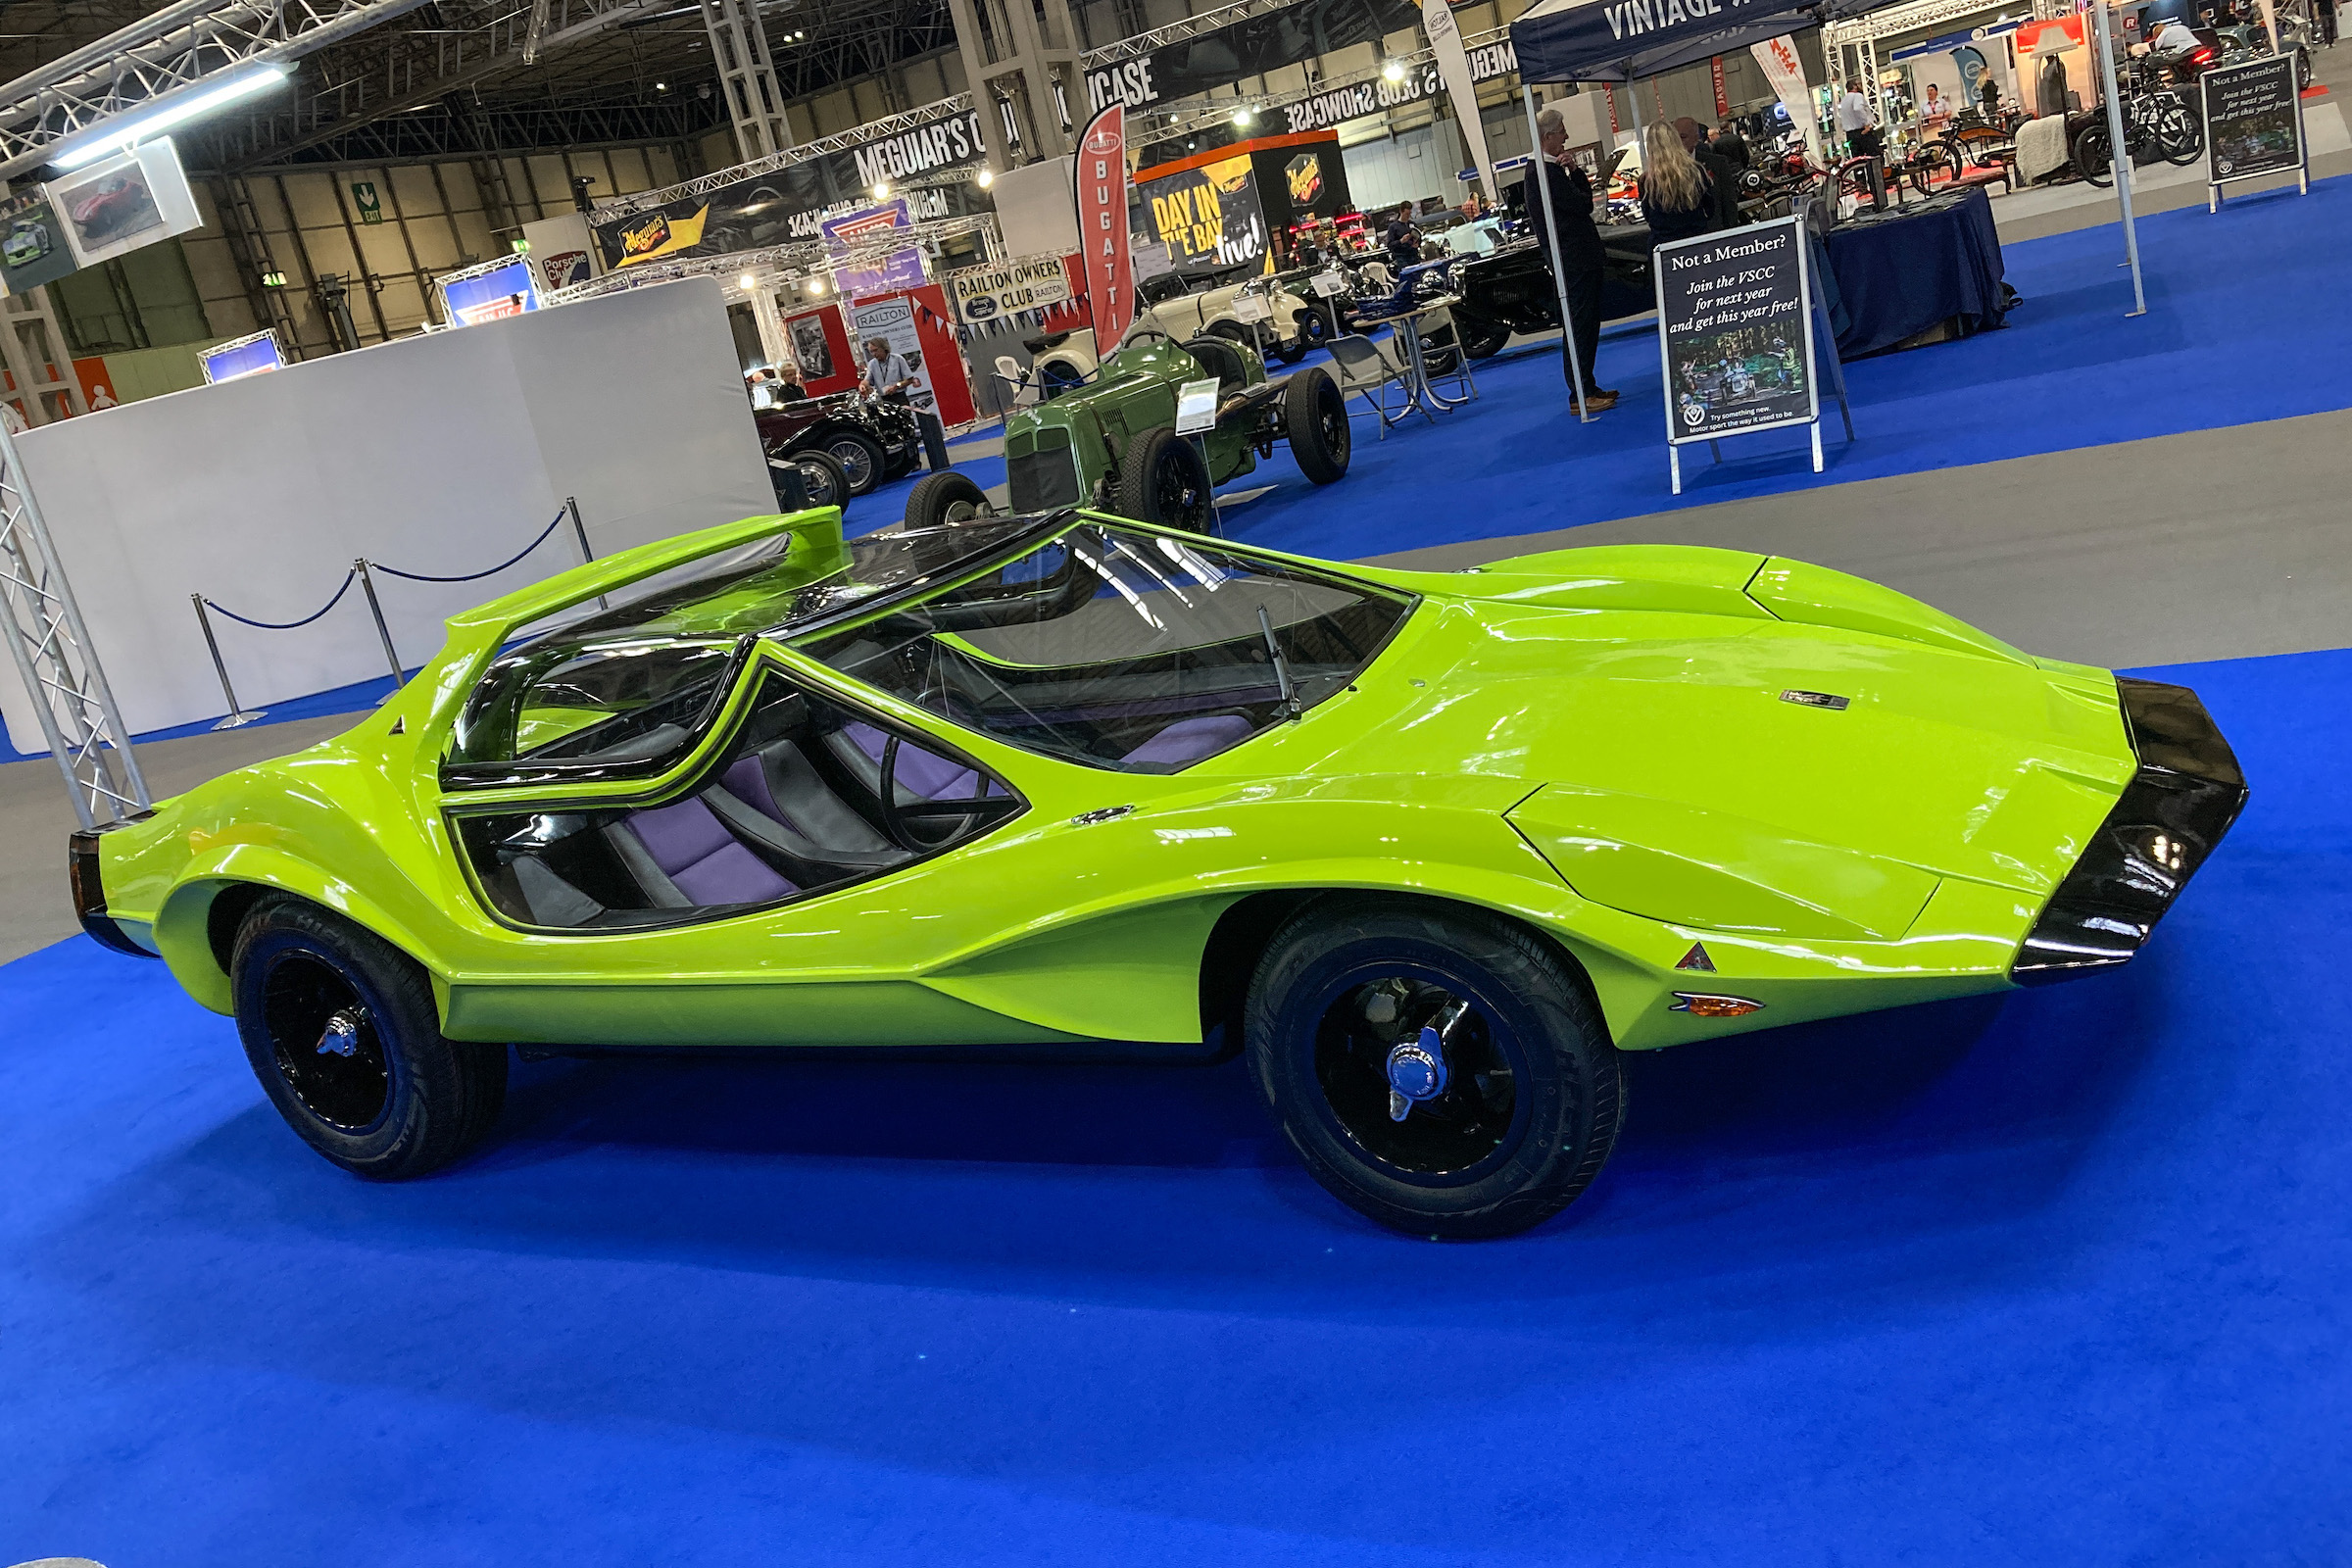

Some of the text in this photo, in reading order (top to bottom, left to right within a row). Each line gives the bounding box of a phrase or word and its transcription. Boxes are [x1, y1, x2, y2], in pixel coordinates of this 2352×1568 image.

[1713, 65, 1725, 104] JAGUAR
[2212, 77, 2231, 87] Not
[2240, 64, 2285, 81] Member?
[2221, 90, 2239, 100] Join
[2254, 81, 2278, 93] VSCC
[2226, 93, 2277, 111] for next year
[2210, 113, 2227, 122] and
[2226, 111, 2239, 121] get
[2240, 107, 2255, 116] this
[2255, 104, 2274, 115] year
[854, 118, 970, 187] MEGUIAR'S
[1152, 181, 1221, 234] DAY IN
[622, 215, 664, 253] Meguiar's
[1095, 160, 1118, 330] BUGATTI
[1195, 218, 1224, 252] BAY
[1215, 213, 1263, 266] live!
[544, 253, 587, 270] Porsche
[1672, 234, 1787, 270] Not a Member?
[547, 267, 570, 281] Club
[958, 260, 1060, 297] RAILTON OWNERS
[1686, 266, 1776, 295] Join the VSCC
[1002, 288, 1034, 309] CLUB
[1036, 284, 1063, 298] RAILTON
[1693, 286, 1773, 315] for next year
[859, 308, 906, 326] RAILTON
[1670, 296, 1798, 333] and get this year free!
[1690, 425, 1709, 434] Motor
[1709, 421, 1727, 431] sport
[1739, 417, 1752, 426] way
[1758, 414, 1775, 422] used
[1721, 408, 1755, 419] something
